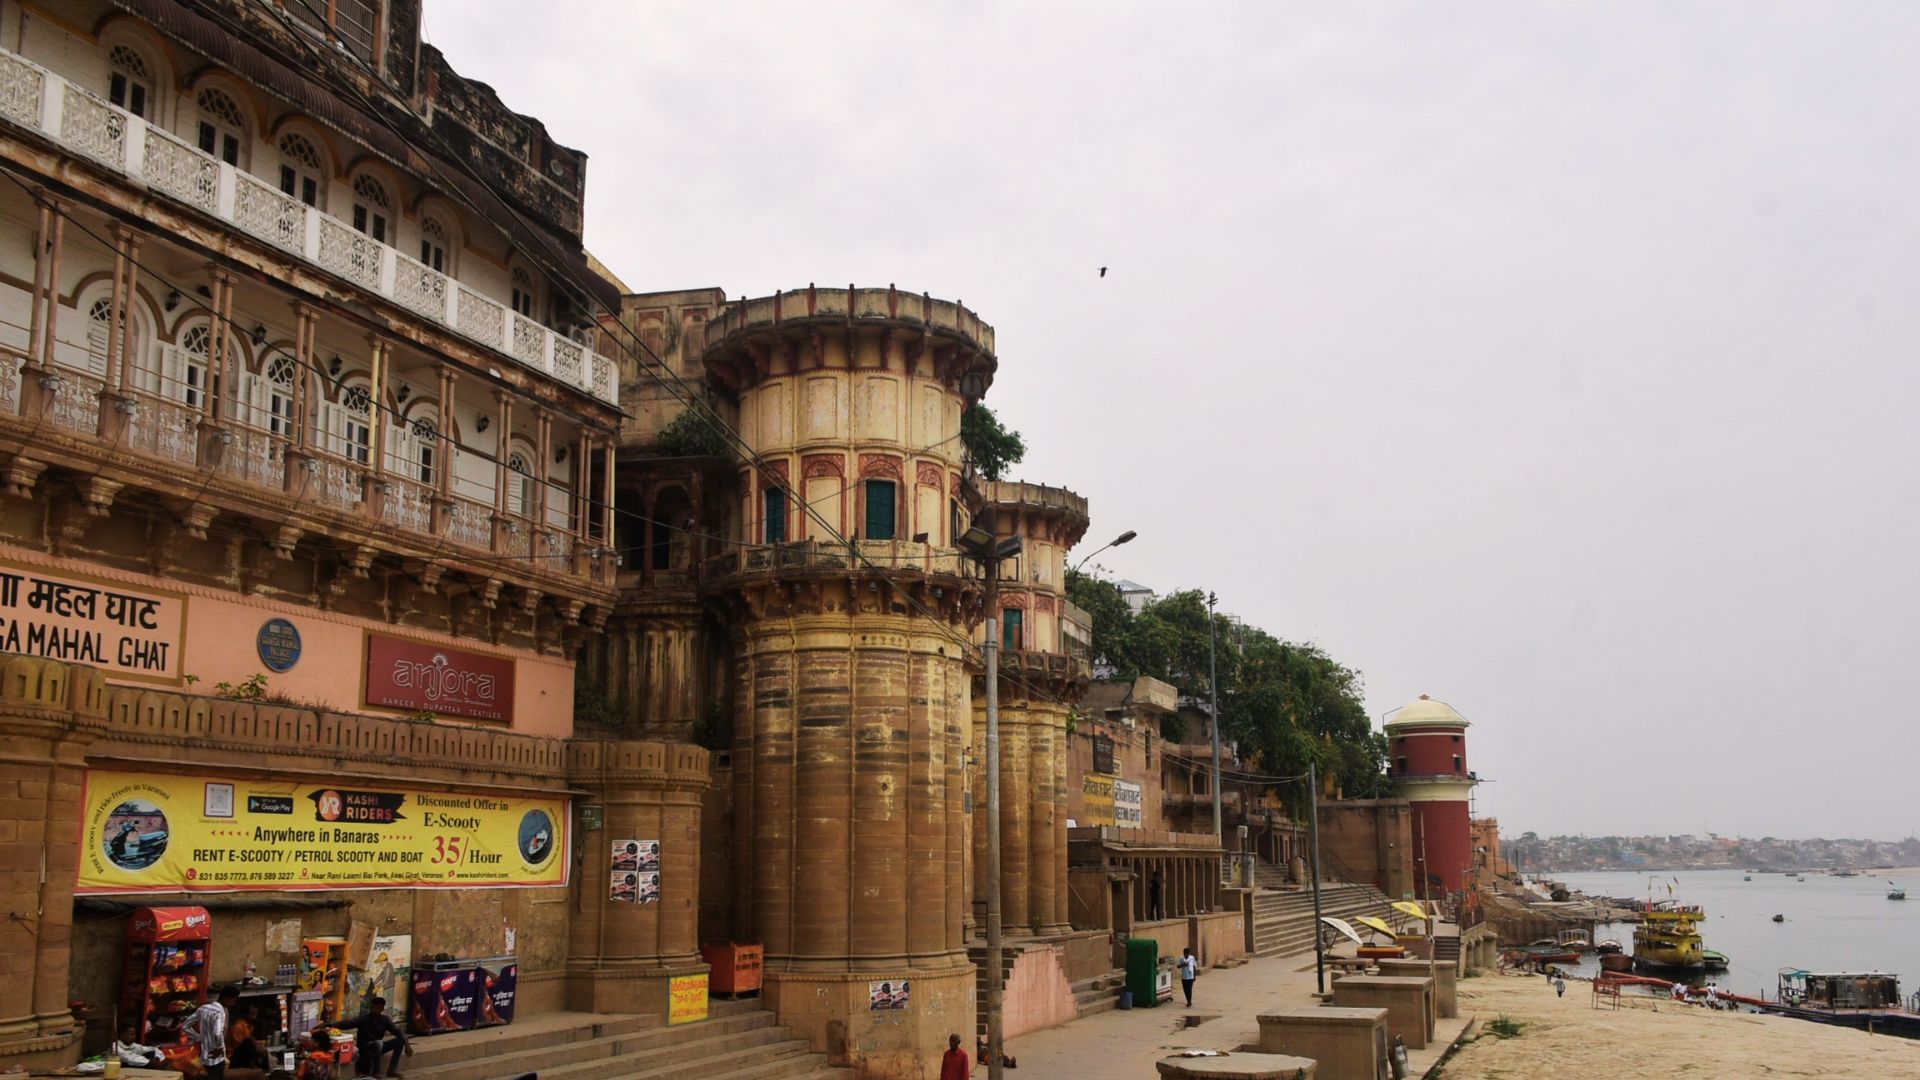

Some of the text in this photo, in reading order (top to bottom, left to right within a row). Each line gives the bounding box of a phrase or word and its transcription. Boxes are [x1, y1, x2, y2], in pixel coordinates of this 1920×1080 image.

[27, 578, 102, 621] महल
[105, 591, 161, 629] घाट
[27, 622, 109, 664] MAHAL
[117, 636, 169, 672] GHAT
[392, 654, 495, 701] anjora
[383, 697, 502, 719] SAREES DUPATTAS TEXTILES
[93, 809, 103, 825] and
[100, 796, 113, 811] ride
[111, 785, 132, 800] freely
[133, 783, 141, 791] in
[142, 783, 171, 801] Varanasi
[261, 803, 291, 812] Google Play
[346, 795, 379, 806] KASHI
[417, 794, 509, 811] Discounted Offer in
[346, 807, 393, 820] RIDERS
[423, 812, 482, 832] E-Scooty
[253, 825, 380, 845] Anywhere in Banaras
[193, 848, 424, 863] RENT E-SCOOTY / PETROL SCOOTY AND BOAT
[469, 849, 503, 864] Hour
[199, 872, 213, 881] 831
[214, 872, 228, 881] 835
[249, 872, 263, 880] 876
[264, 872, 277, 880] 589
[277, 872, 295, 880] 3227
[311, 872, 326, 880] Near
[363, 872, 373, 880] Bai
[390, 872, 404, 880] Assi
